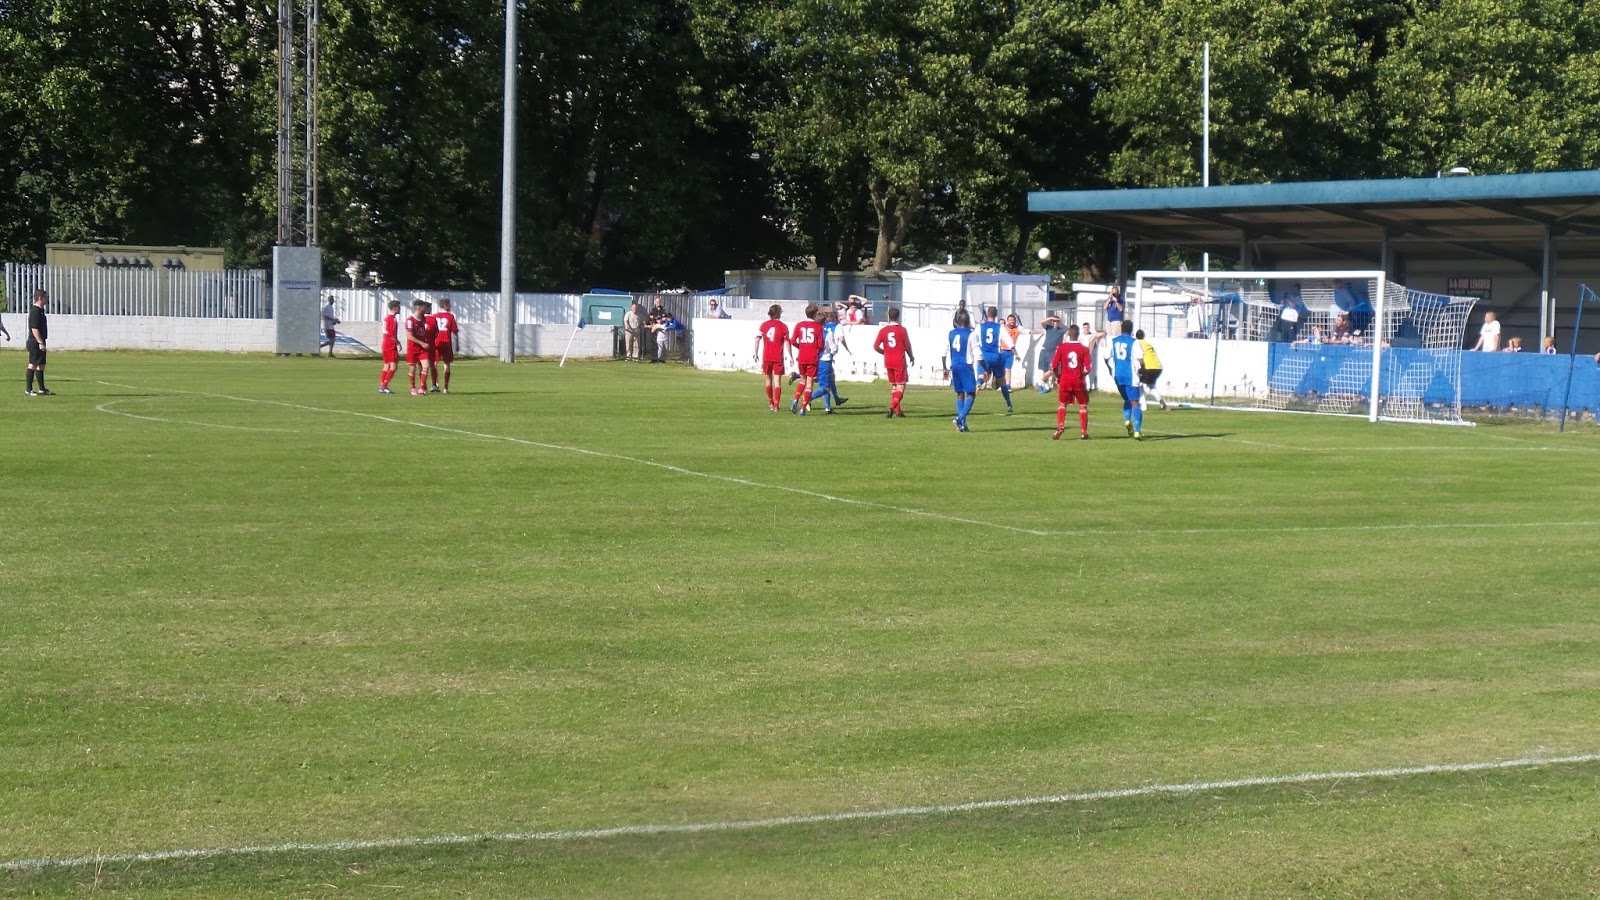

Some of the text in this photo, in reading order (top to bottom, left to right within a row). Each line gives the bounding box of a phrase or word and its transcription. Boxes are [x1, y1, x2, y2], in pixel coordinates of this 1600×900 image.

[436, 317, 449, 331] 12
[766, 326, 776, 342] 4
[800, 327, 815, 344] 15
[887, 331, 897, 348] 5
[985, 327, 994, 344] 5
[952, 334, 961, 352] 4
[1114, 341, 1128, 360] 15
[1067, 351, 1078, 369] 3
